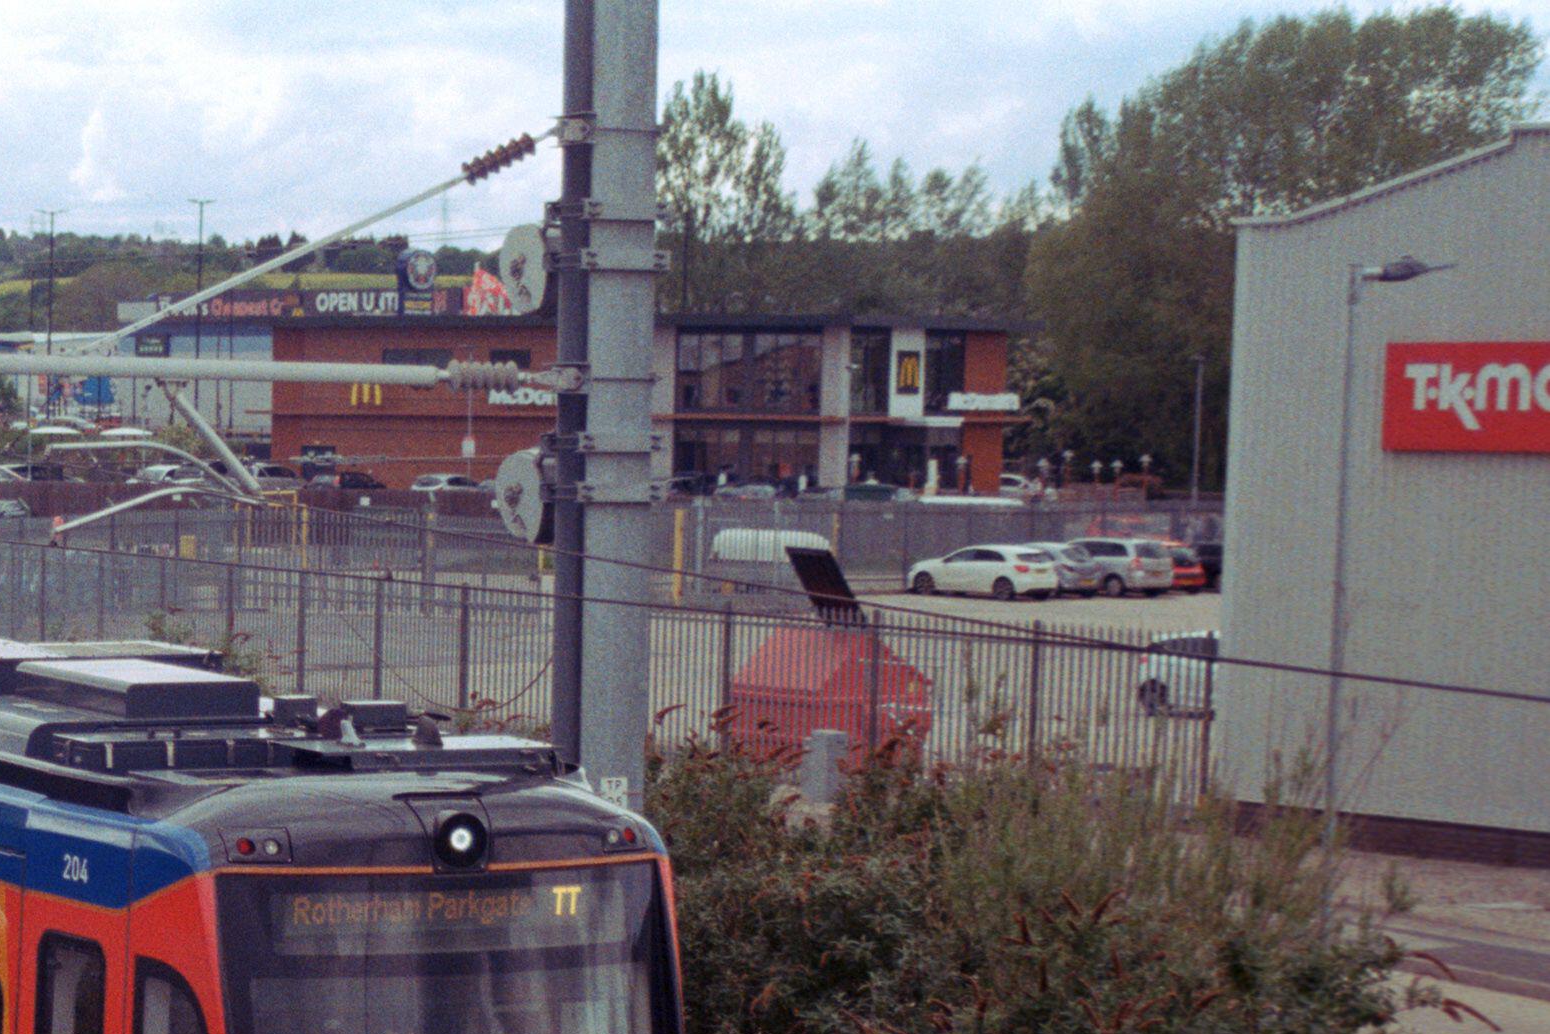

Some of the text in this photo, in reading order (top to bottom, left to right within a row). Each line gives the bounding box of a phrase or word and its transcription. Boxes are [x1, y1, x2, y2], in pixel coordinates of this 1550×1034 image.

[315, 292, 358, 312] OPEN
[62, 853, 88, 884] 204
[293, 884, 582, 926] Rotherham Parkgate TT
